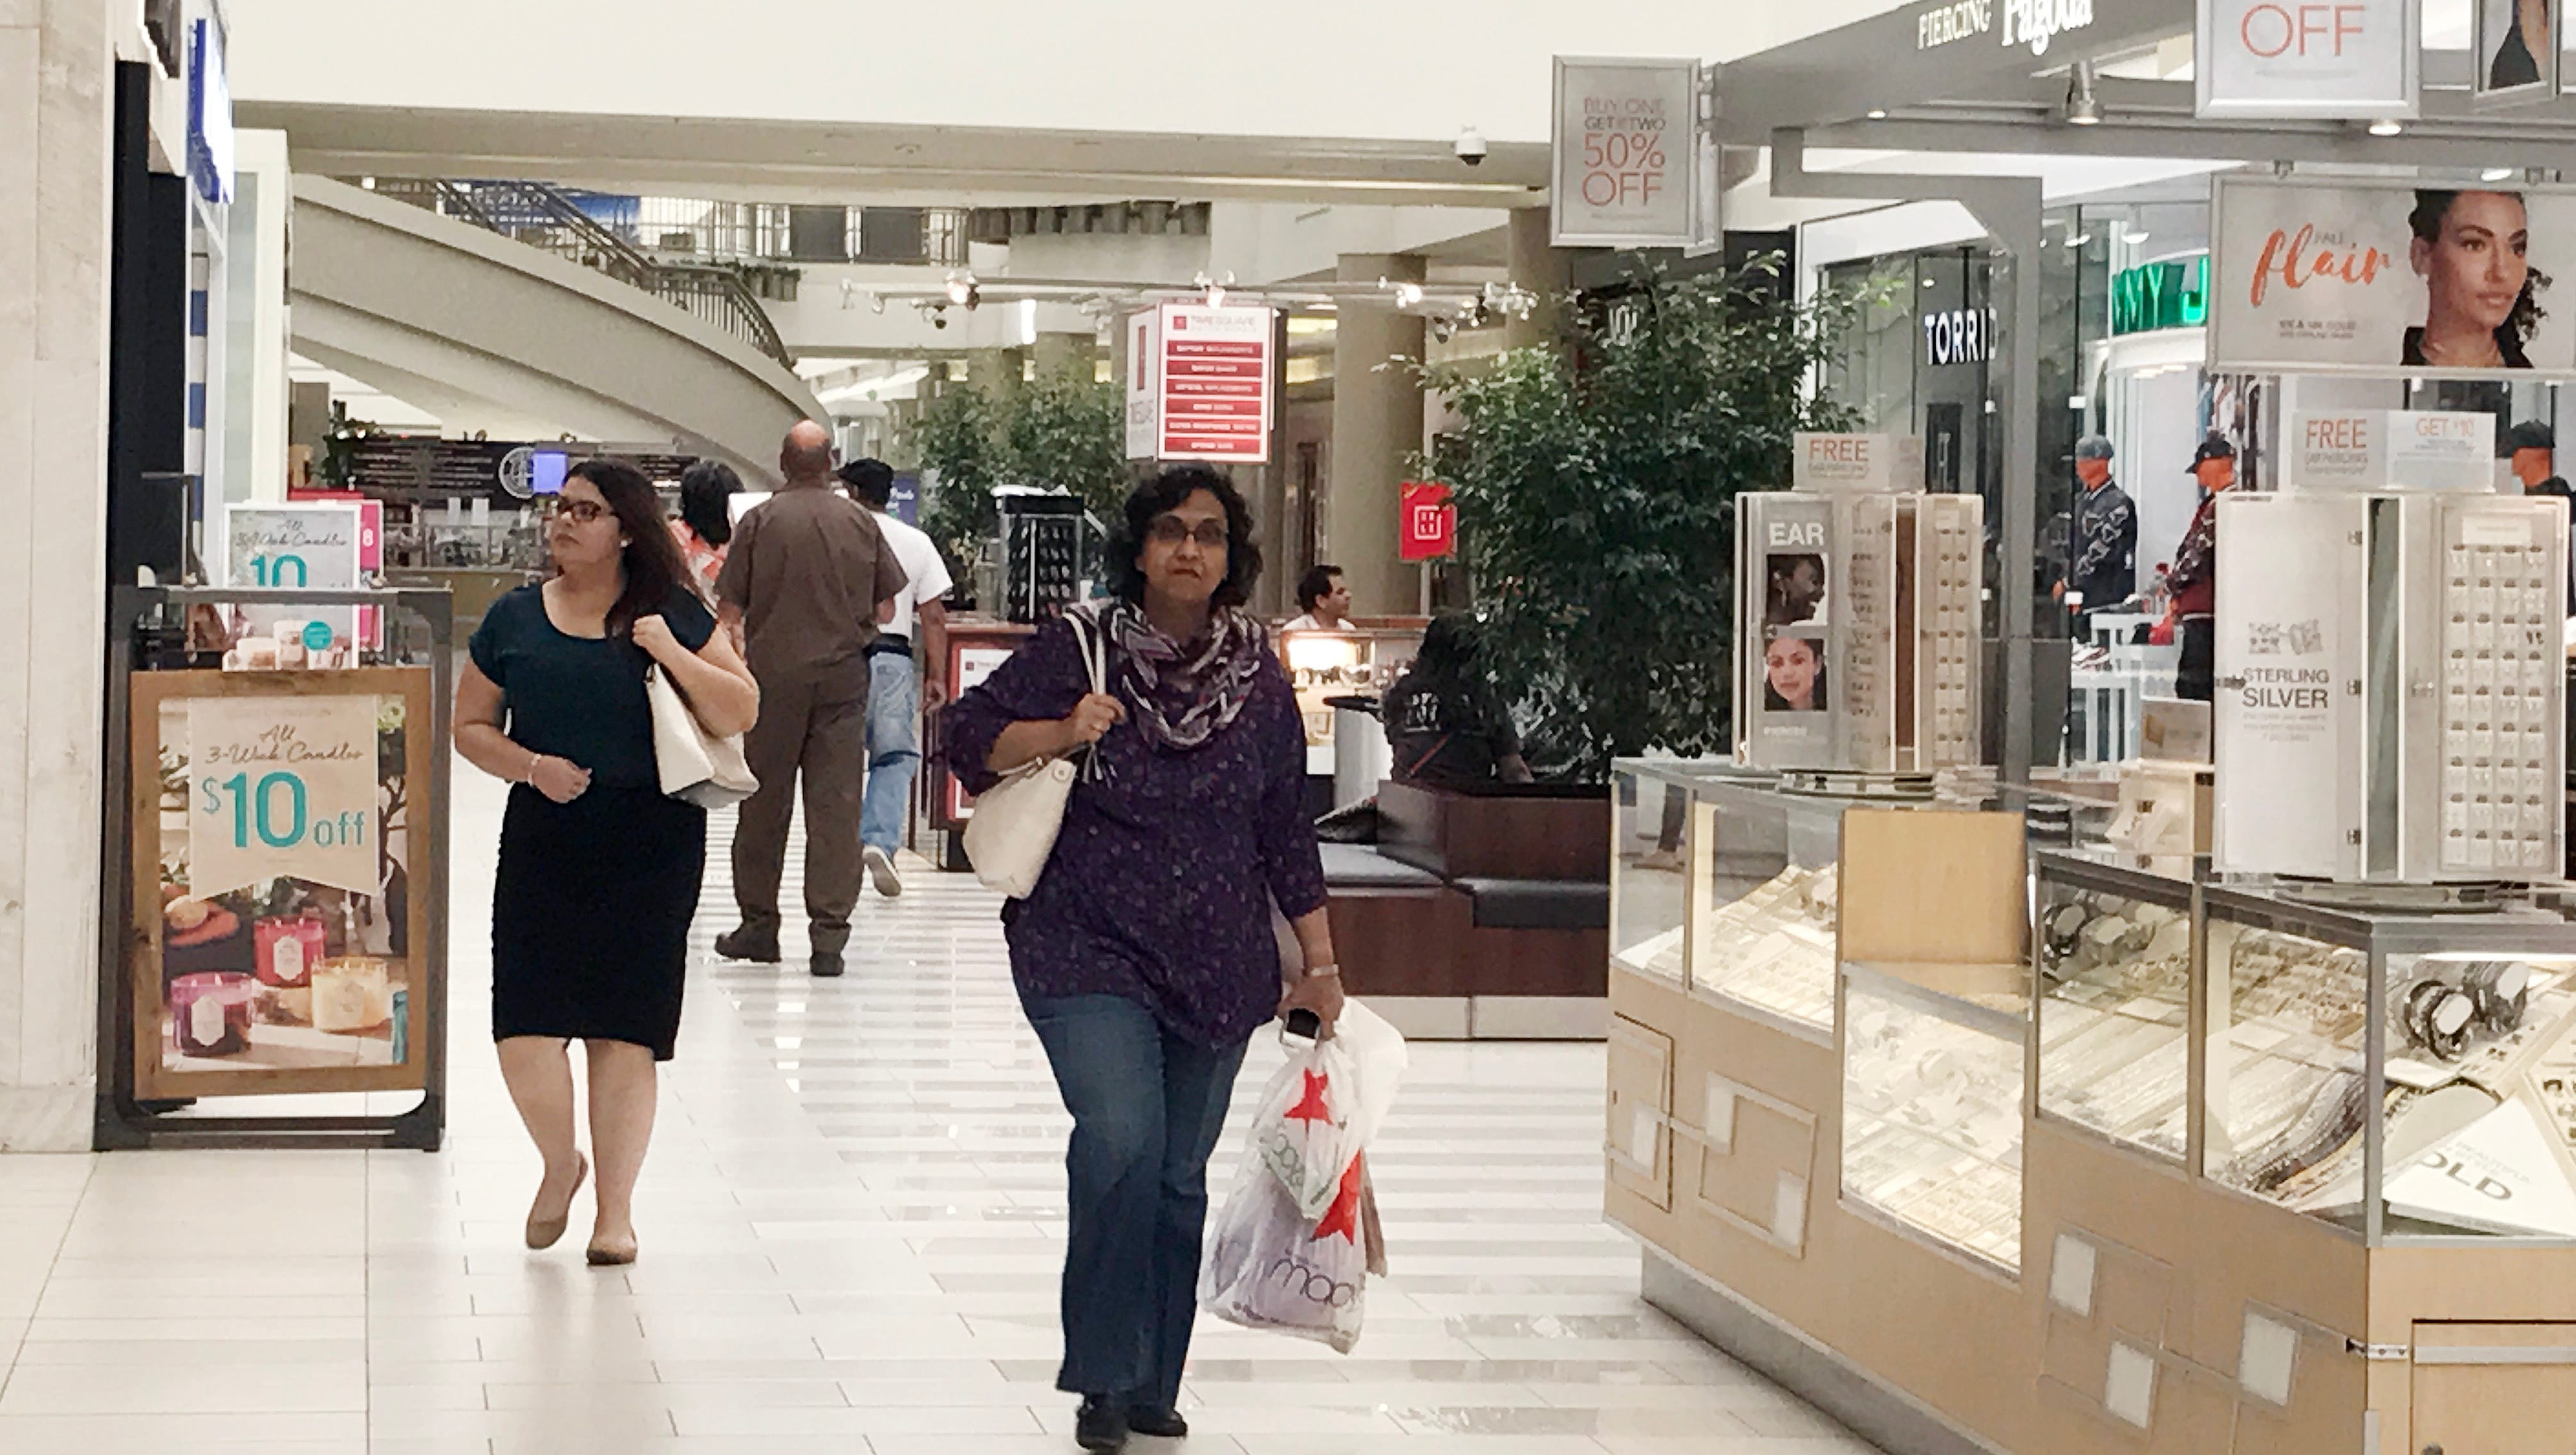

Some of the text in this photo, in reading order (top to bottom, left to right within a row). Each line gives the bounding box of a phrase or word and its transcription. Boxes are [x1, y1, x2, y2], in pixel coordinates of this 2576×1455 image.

[1918, 0, 1992, 49] PIERCING
[2242, 4, 2365, 58] OFF
[1584, 97, 1665, 115] BUY ONE
[1584, 117, 1615, 131] GET
[1584, 133, 1666, 168] 50%
[1582, 171, 1664, 206] OFF
[2250, 223, 2391, 308] flair
[2305, 418, 2367, 449] FREE
[2416, 417, 2449, 437] GET
[1809, 439, 1870, 462] FREE
[1768, 523, 1824, 547] EAR
[2242, 667, 2330, 684] STERLING
[2242, 687, 2329, 709] SILVER
[313, 811, 365, 846] off
